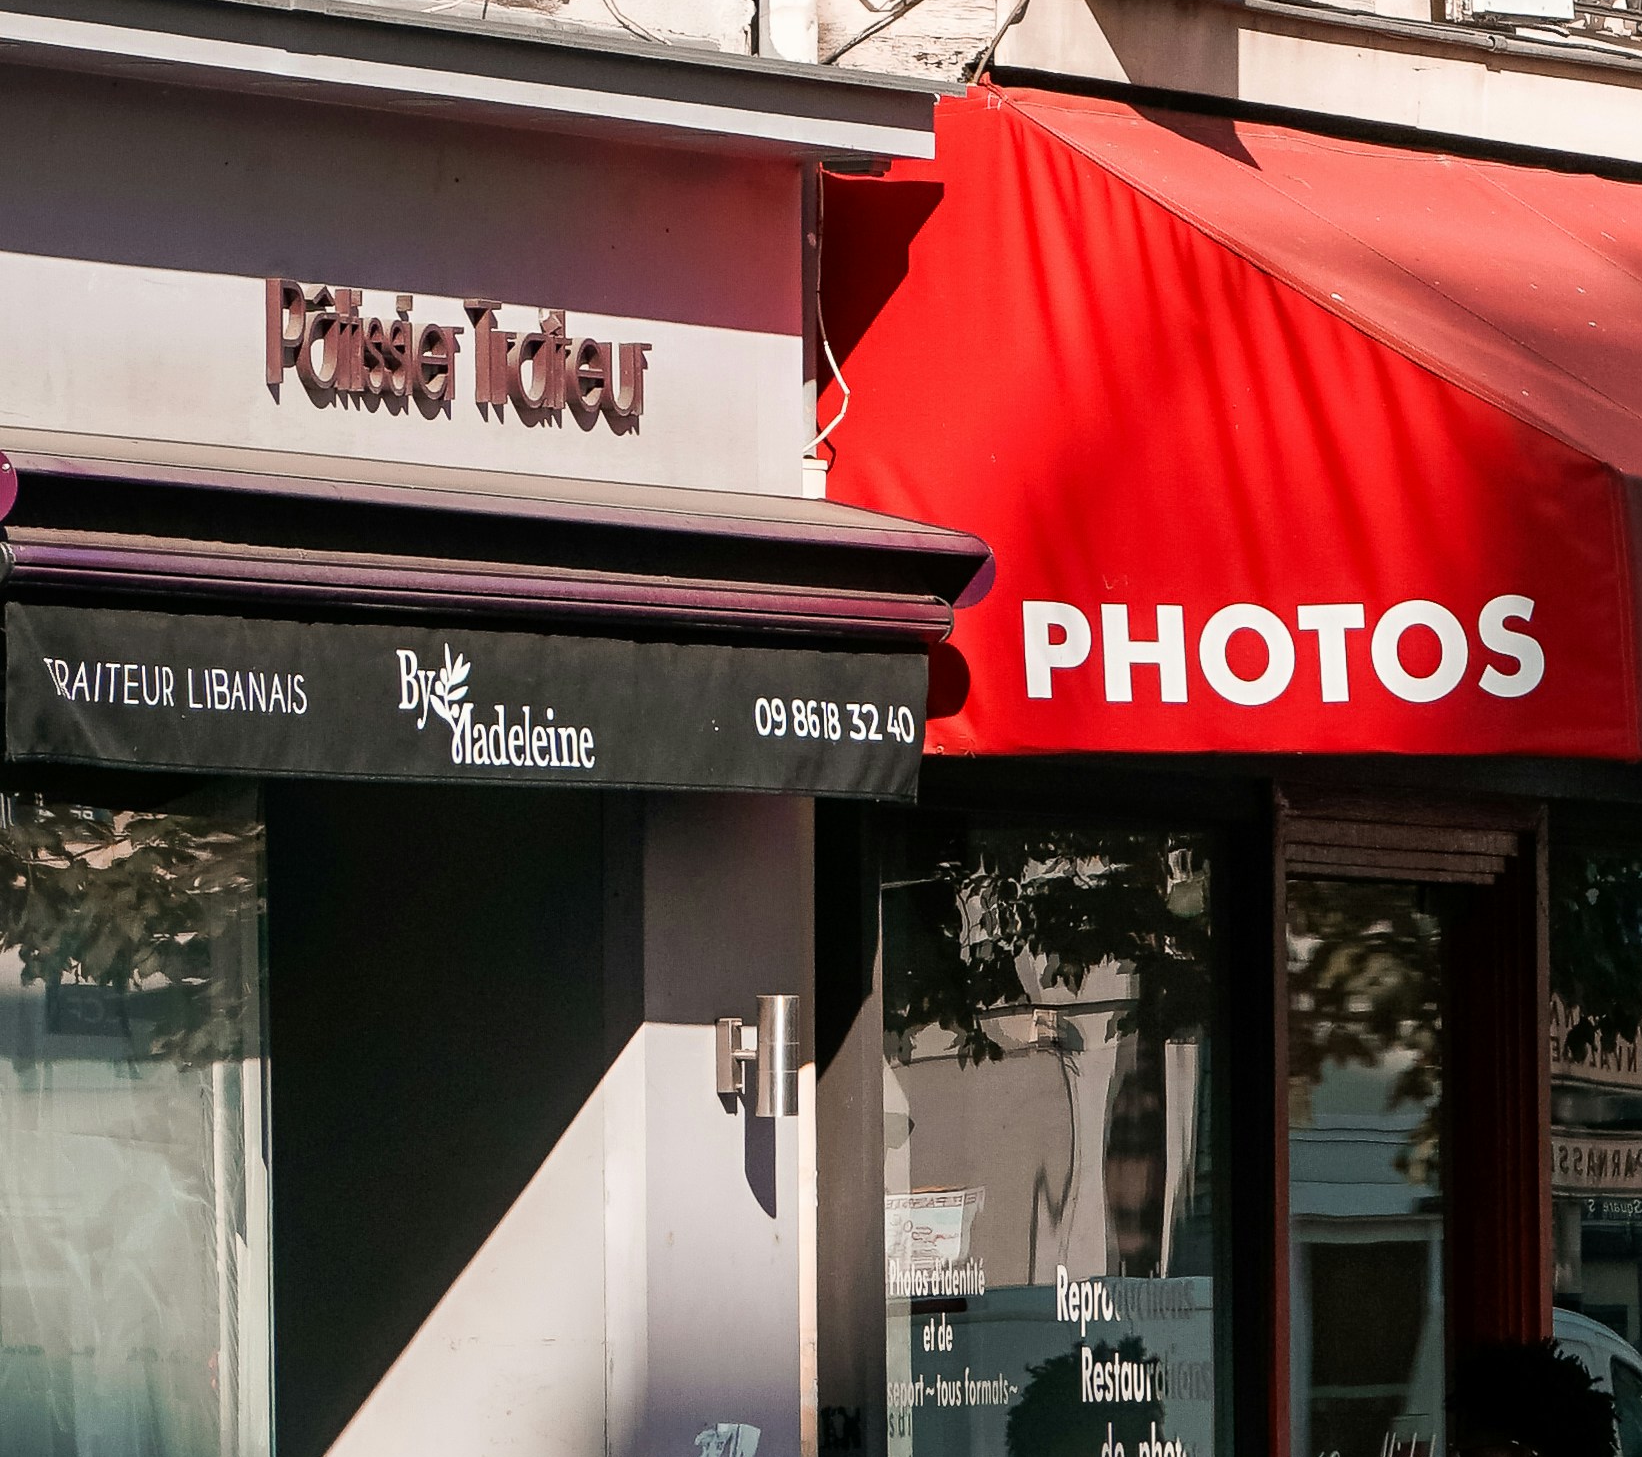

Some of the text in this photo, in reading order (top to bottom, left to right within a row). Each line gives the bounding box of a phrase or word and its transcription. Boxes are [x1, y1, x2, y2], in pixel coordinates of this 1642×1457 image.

[265, 277, 653, 416] Pâtissier Traiteur
[1021, 594, 1546, 707] PHOTOS
[43, 657, 309, 714] TRAITEUR LIBANAIS
[396, 649, 436, 730] By
[450, 702, 596, 769] Madeleine
[755, 697, 787, 737] 09
[846, 703, 883, 740] 32
[887, 705, 914, 744] 40
[889, 1256, 986, 1297] Photos d'identité
[923, 1311, 954, 1353] et de
[936, 1373, 962, 1408] tous
[964, 1366, 1010, 1406] formats
